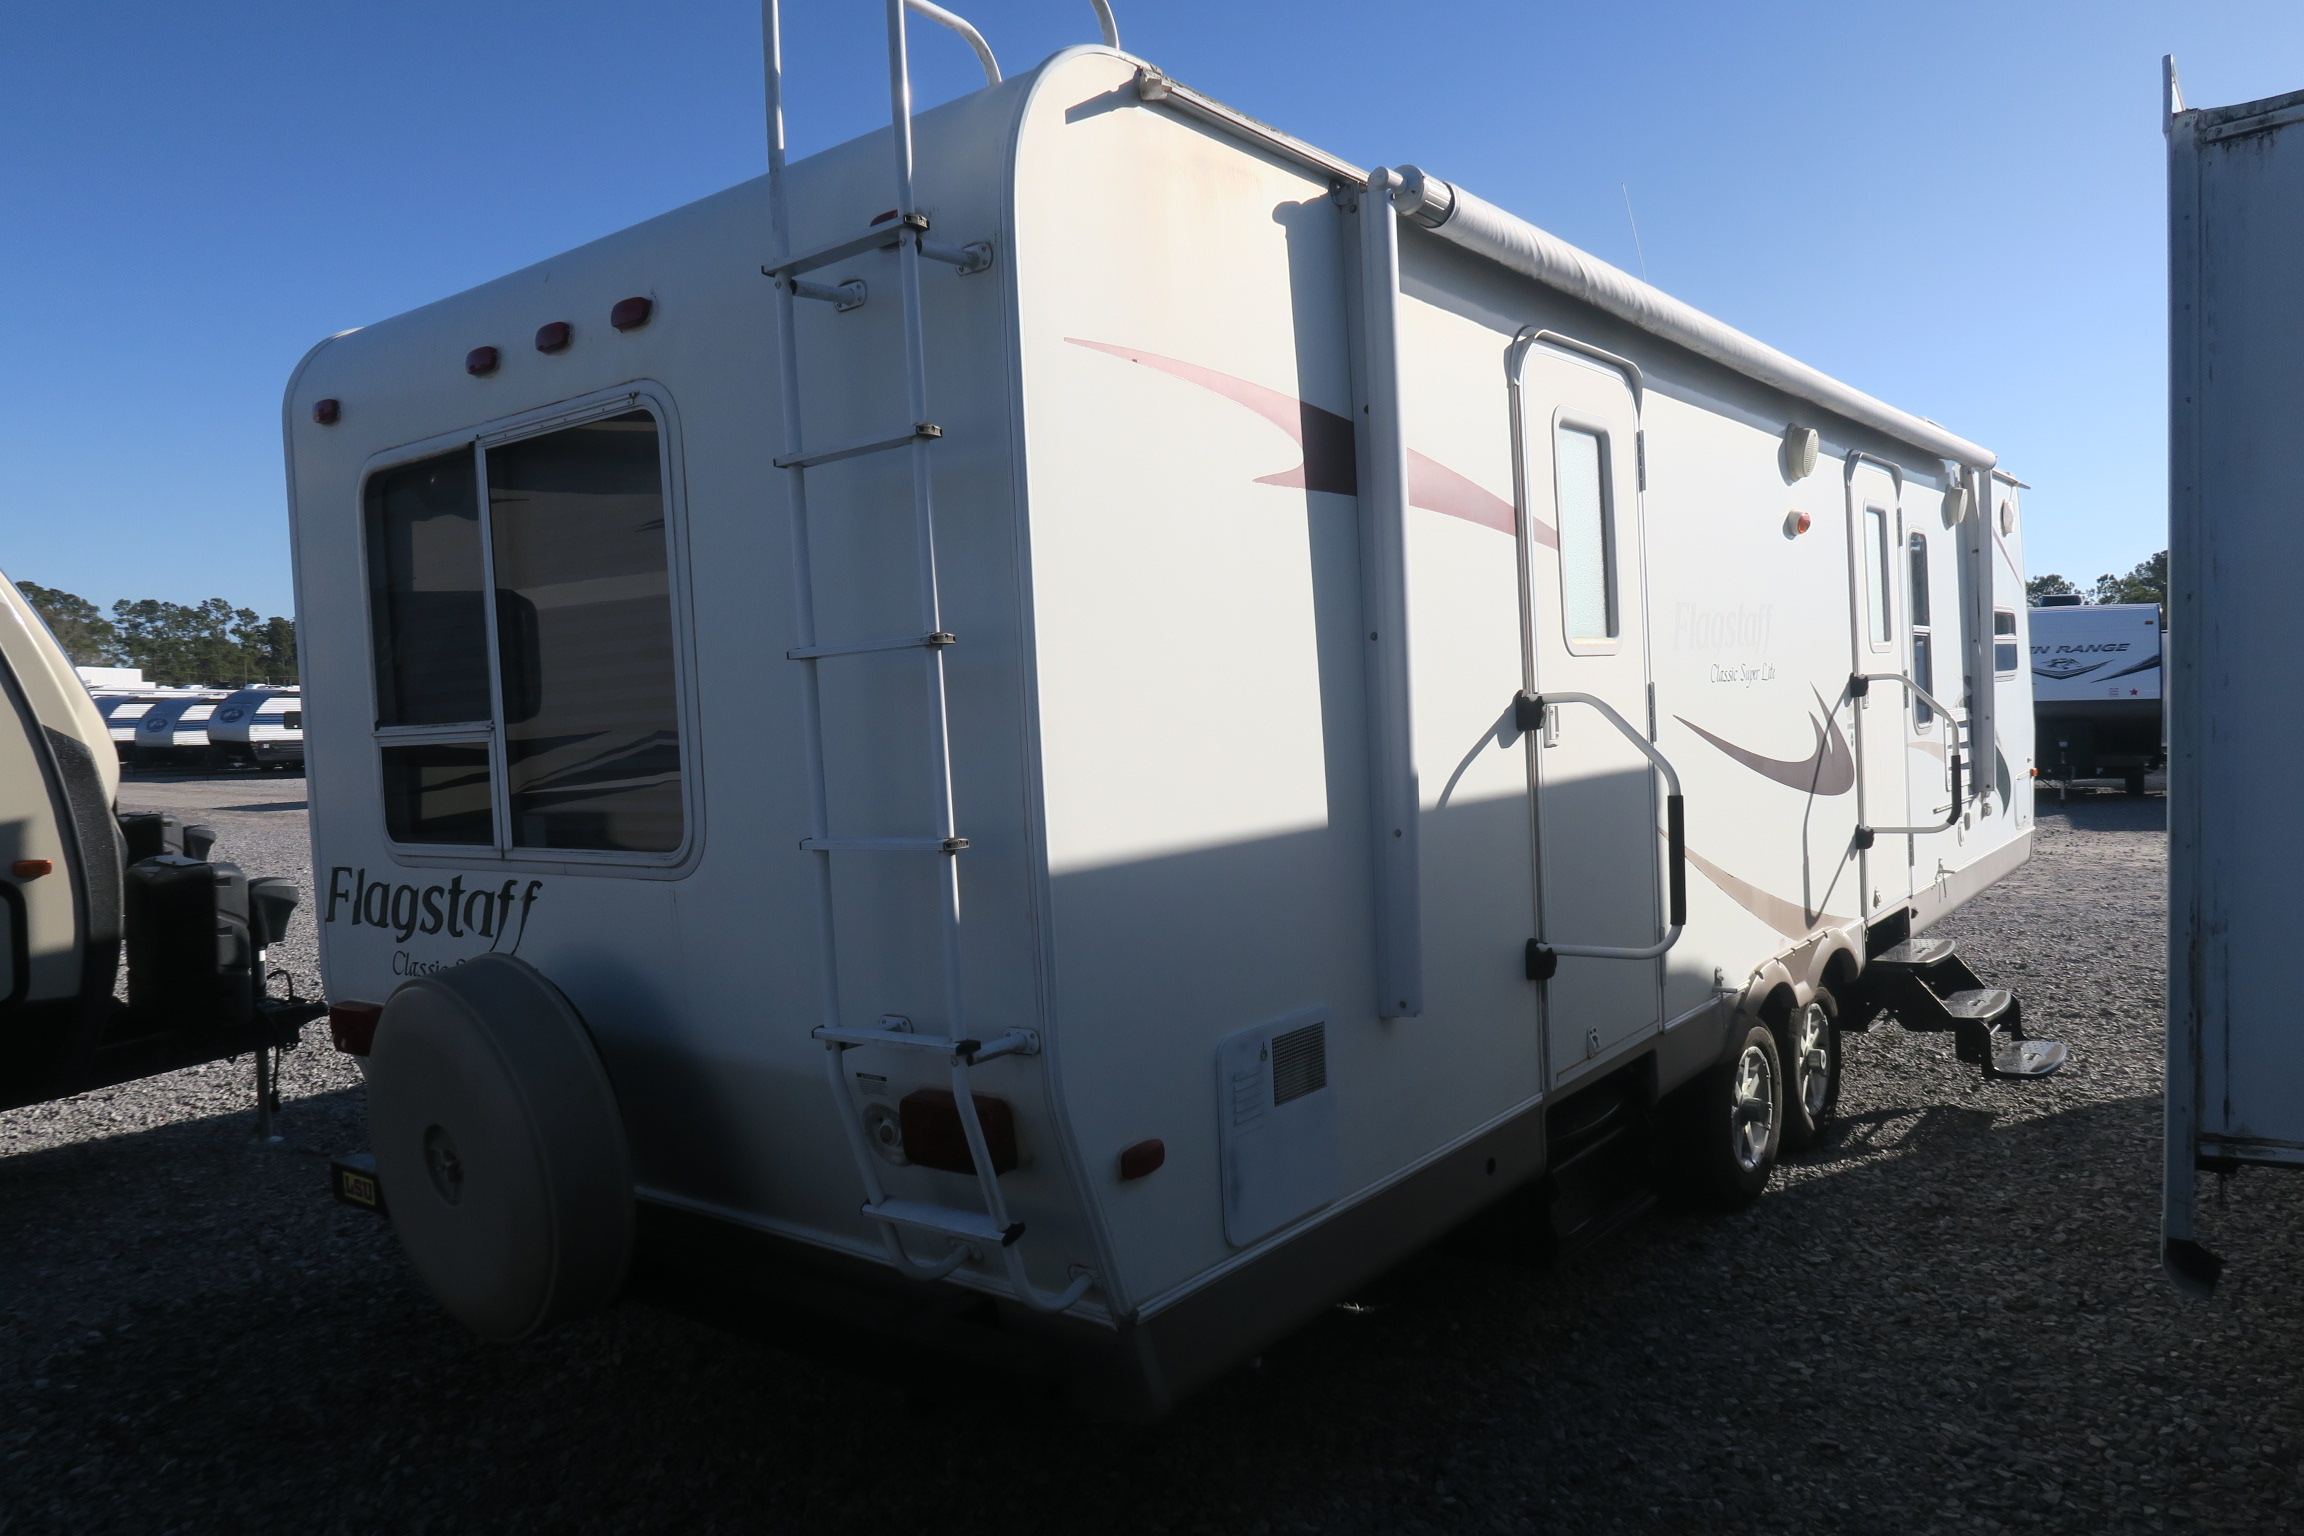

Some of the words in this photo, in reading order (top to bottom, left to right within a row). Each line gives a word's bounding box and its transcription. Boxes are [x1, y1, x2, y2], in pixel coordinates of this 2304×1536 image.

[1671, 600, 1775, 658] Flagstaff
[2055, 643, 2131, 653] RANGE
[1710, 662, 1739, 683] Classic
[1739, 662, 1760, 689] Super
[1761, 662, 1776, 681] Lite
[325, 866, 543, 955] Flagstaff
